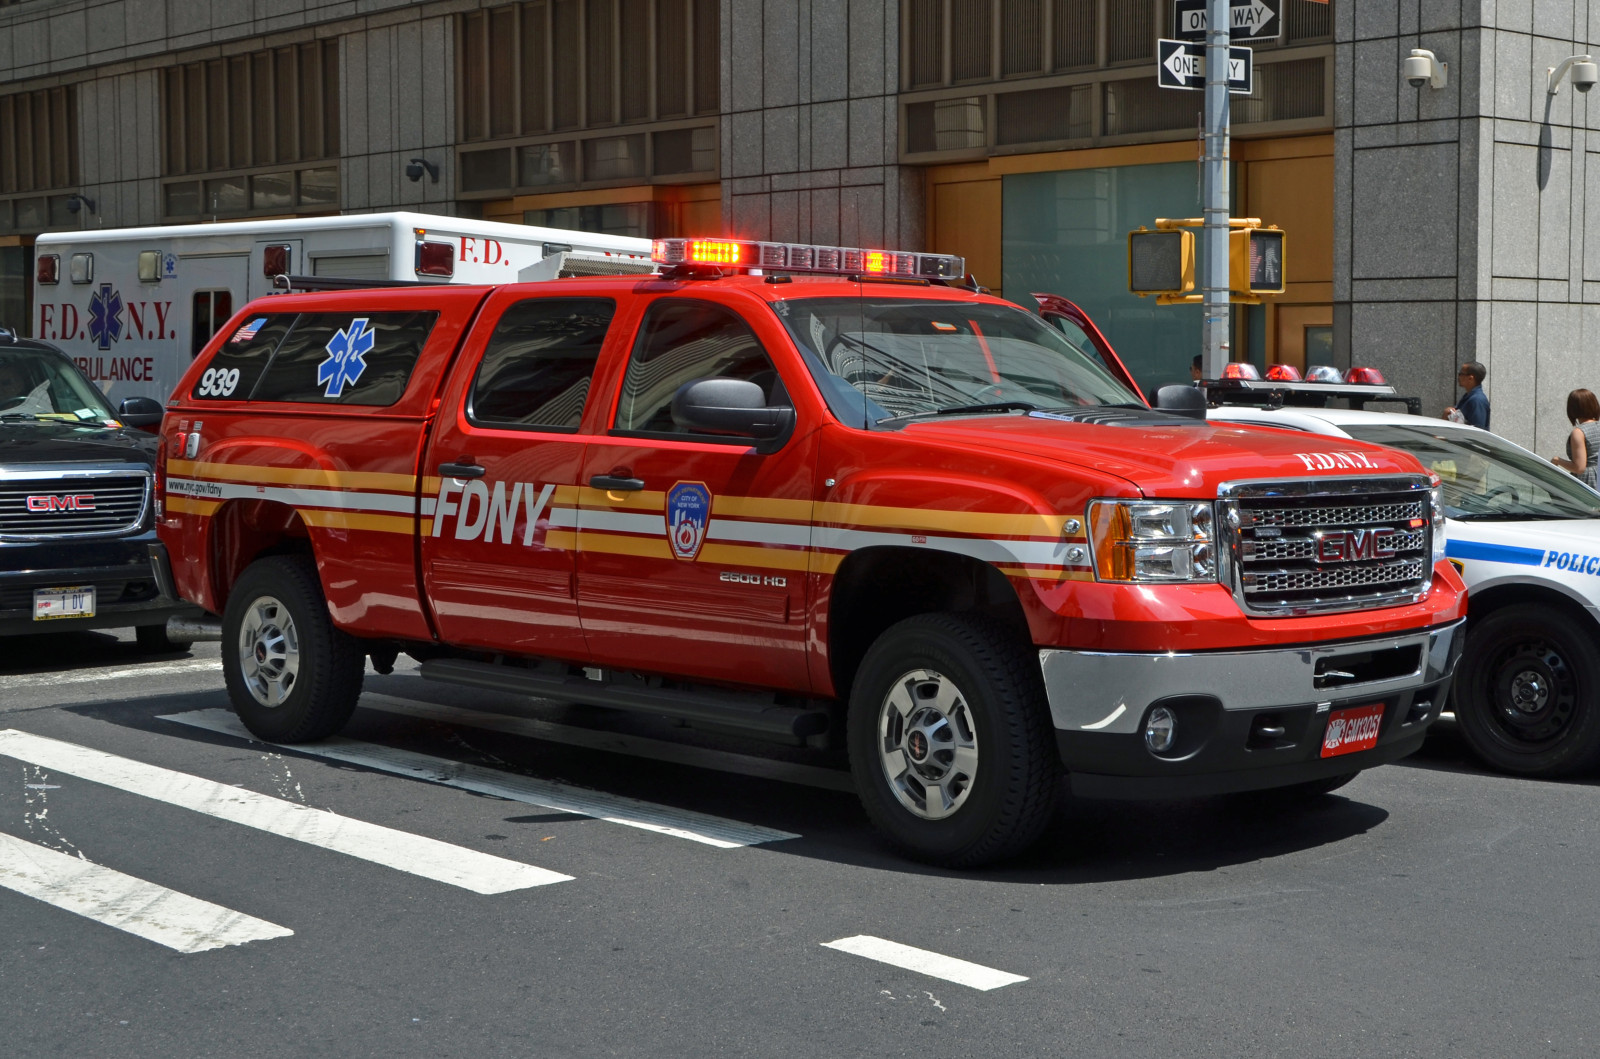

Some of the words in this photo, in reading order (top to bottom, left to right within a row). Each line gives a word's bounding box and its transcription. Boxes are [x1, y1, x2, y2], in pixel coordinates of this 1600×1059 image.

[1190, 12, 1207, 29] ON
[1233, 7, 1265, 26] WAY
[1173, 56, 1199, 75] ONE
[459, 236, 510, 267] F.D.
[39, 303, 85, 340] F.D.
[125, 301, 176, 340] N.Y.
[73, 356, 154, 382] BULANCE
[199, 367, 240, 397] 939
[1294, 451, 1380, 471] F.D.N.Y.
[168, 481, 223, 498] www.nyc.gov/fdny
[26, 494, 96, 512] GMC
[432, 479, 556, 547] FDNY
[1313, 526, 1396, 563] GMC
[763, 575, 787, 588] HD
[72, 594, 85, 610] DV
[1344, 713, 1382, 745] GM13051
